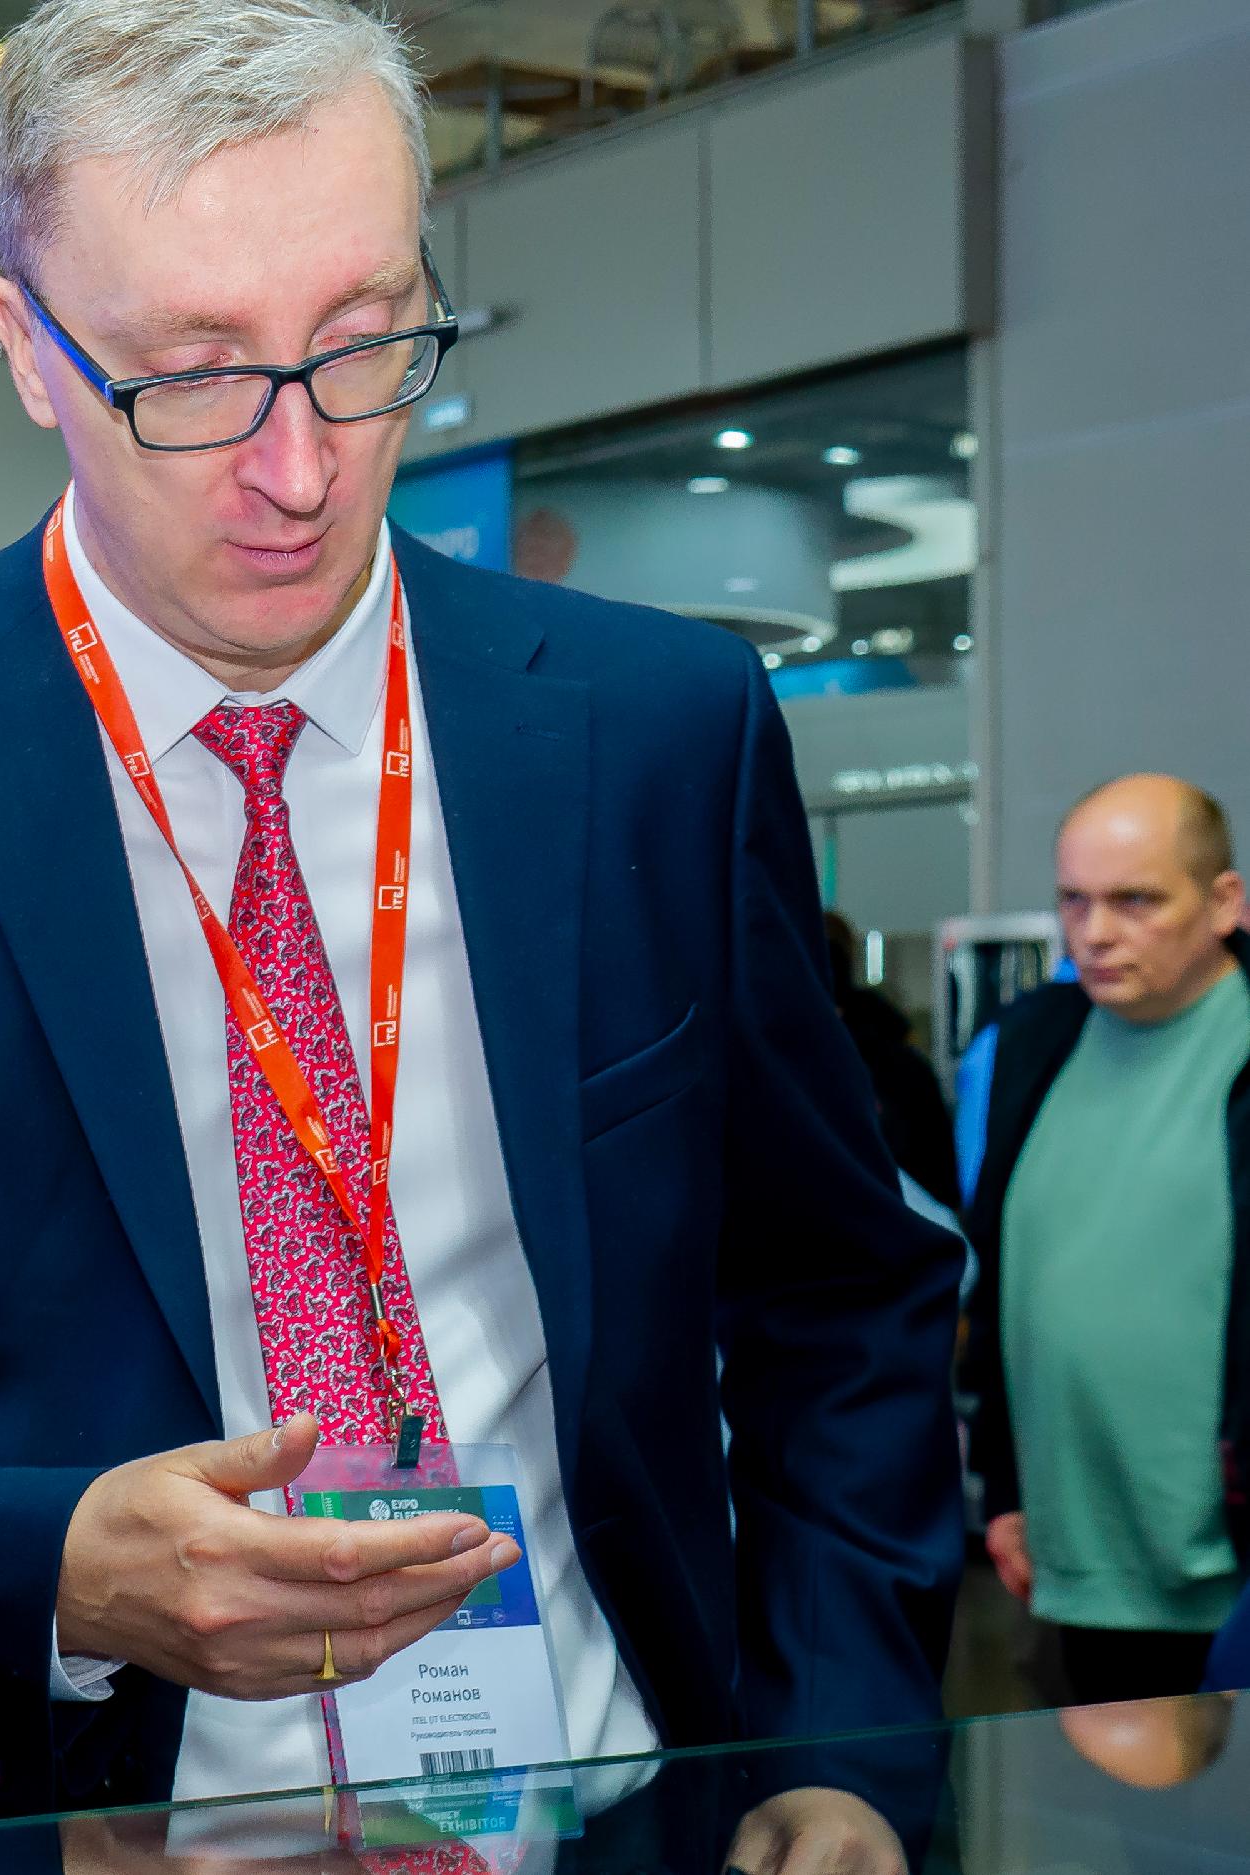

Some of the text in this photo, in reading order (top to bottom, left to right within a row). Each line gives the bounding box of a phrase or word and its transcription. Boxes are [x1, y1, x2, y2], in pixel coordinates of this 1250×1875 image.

[391, 1499, 419, 1510] EXPO
[418, 1663, 469, 1679] Роман
[411, 1688, 481, 1704] Романов
[439, 1816, 507, 1833] EXHIBITOR
